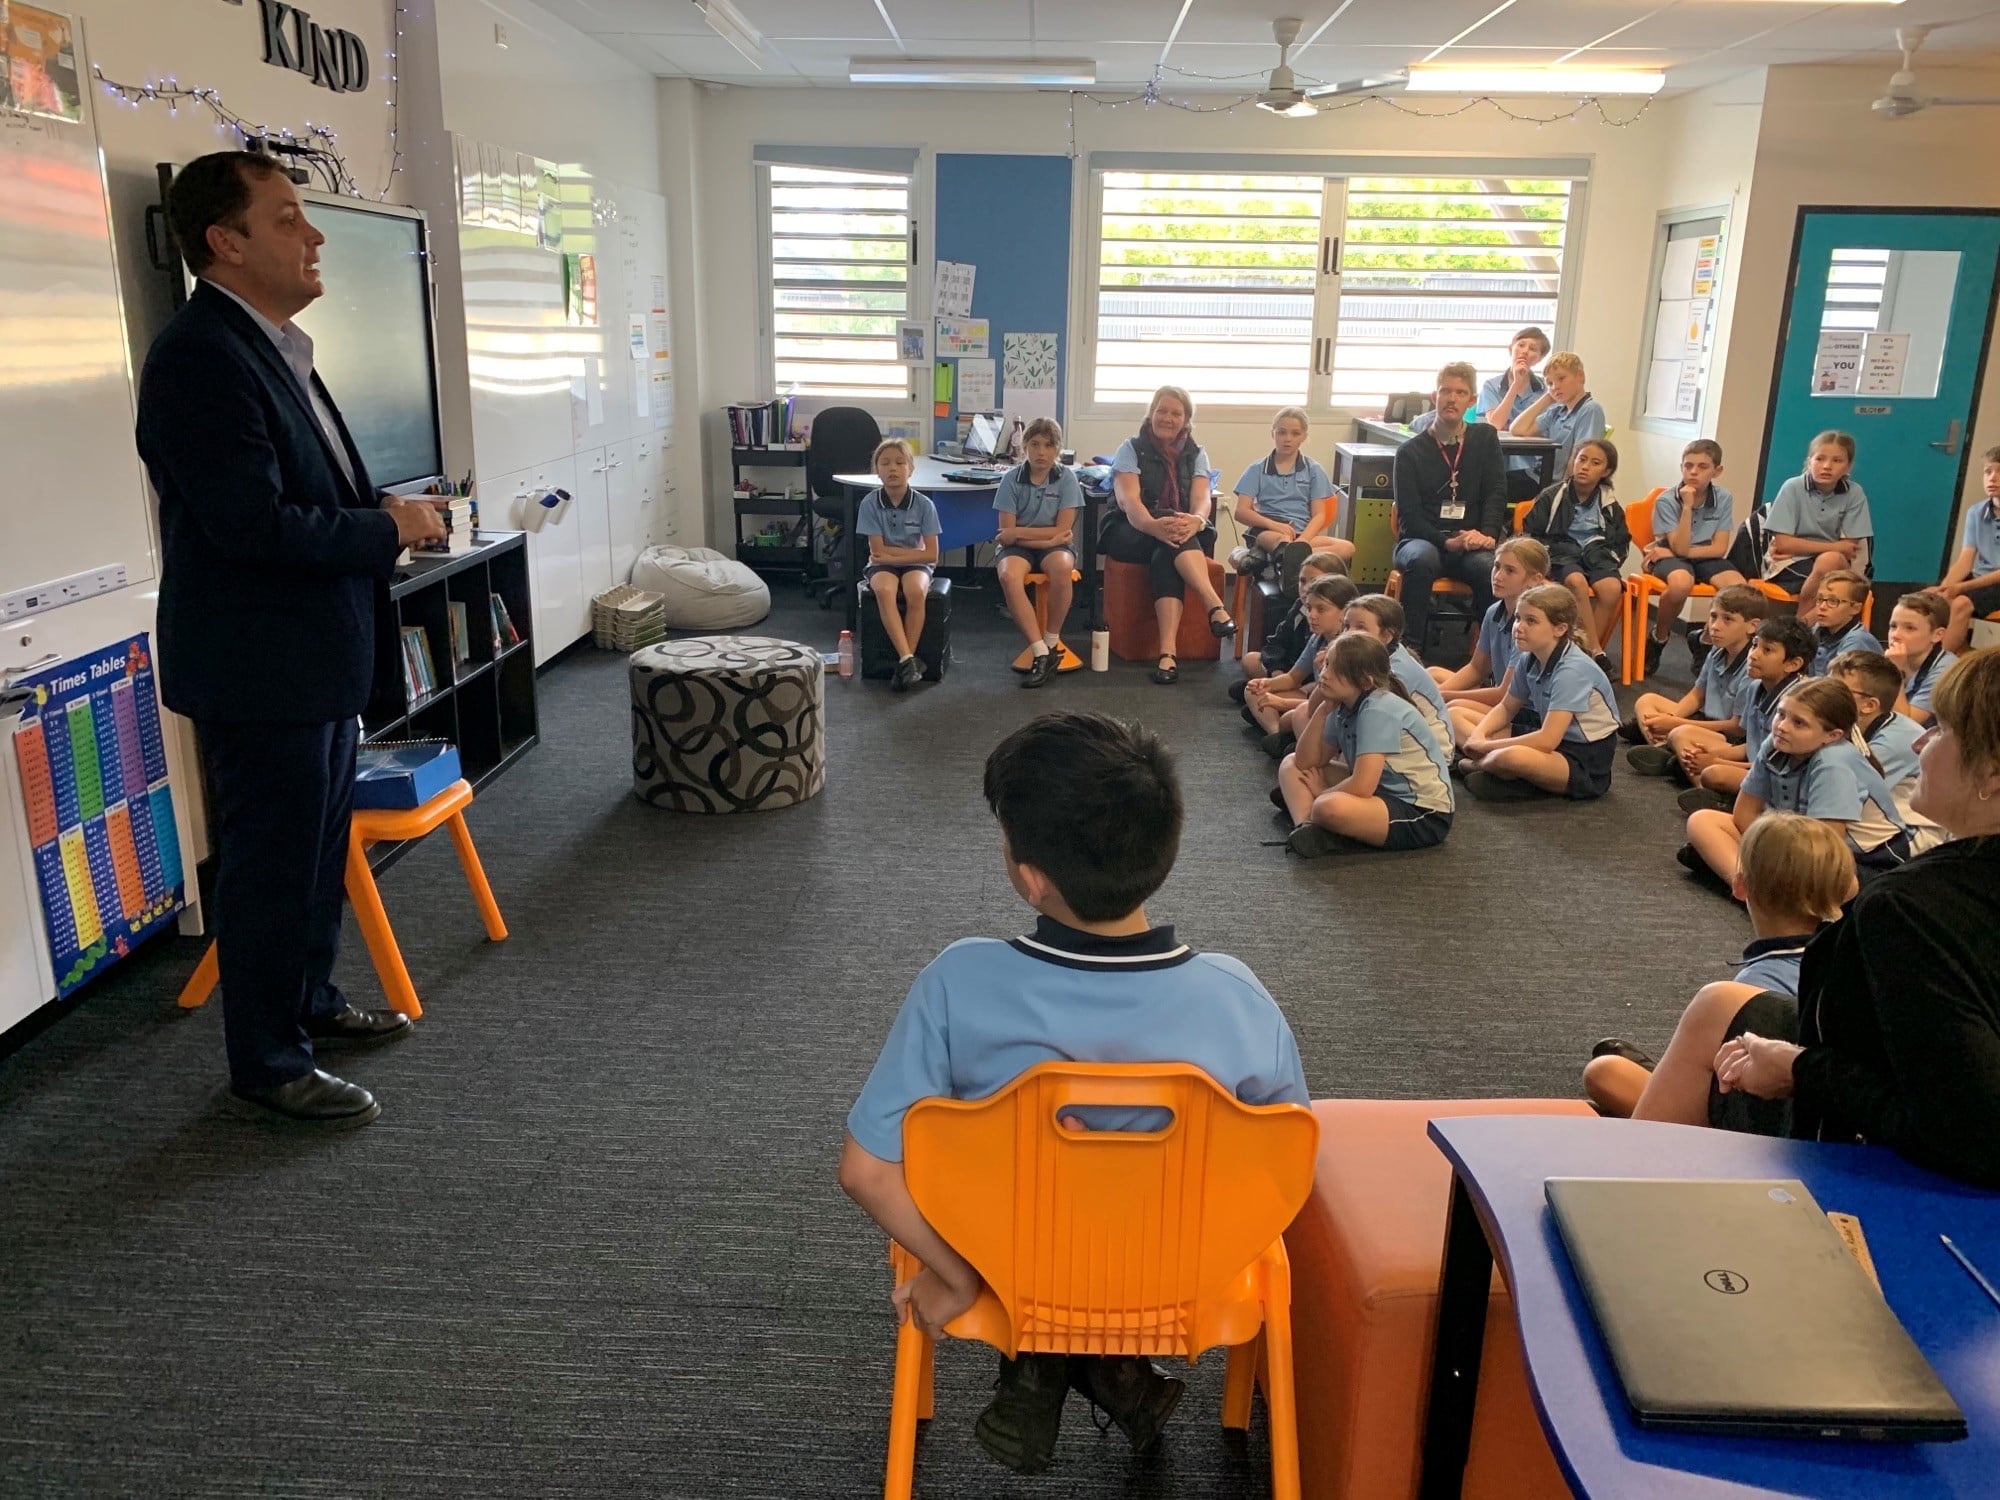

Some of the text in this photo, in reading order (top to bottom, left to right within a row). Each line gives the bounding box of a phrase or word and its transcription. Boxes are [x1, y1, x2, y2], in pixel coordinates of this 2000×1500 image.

[258, 0, 369, 93] KIND
[1833, 361, 1855, 369] YOU
[50, 656, 126, 695] Times Tables
